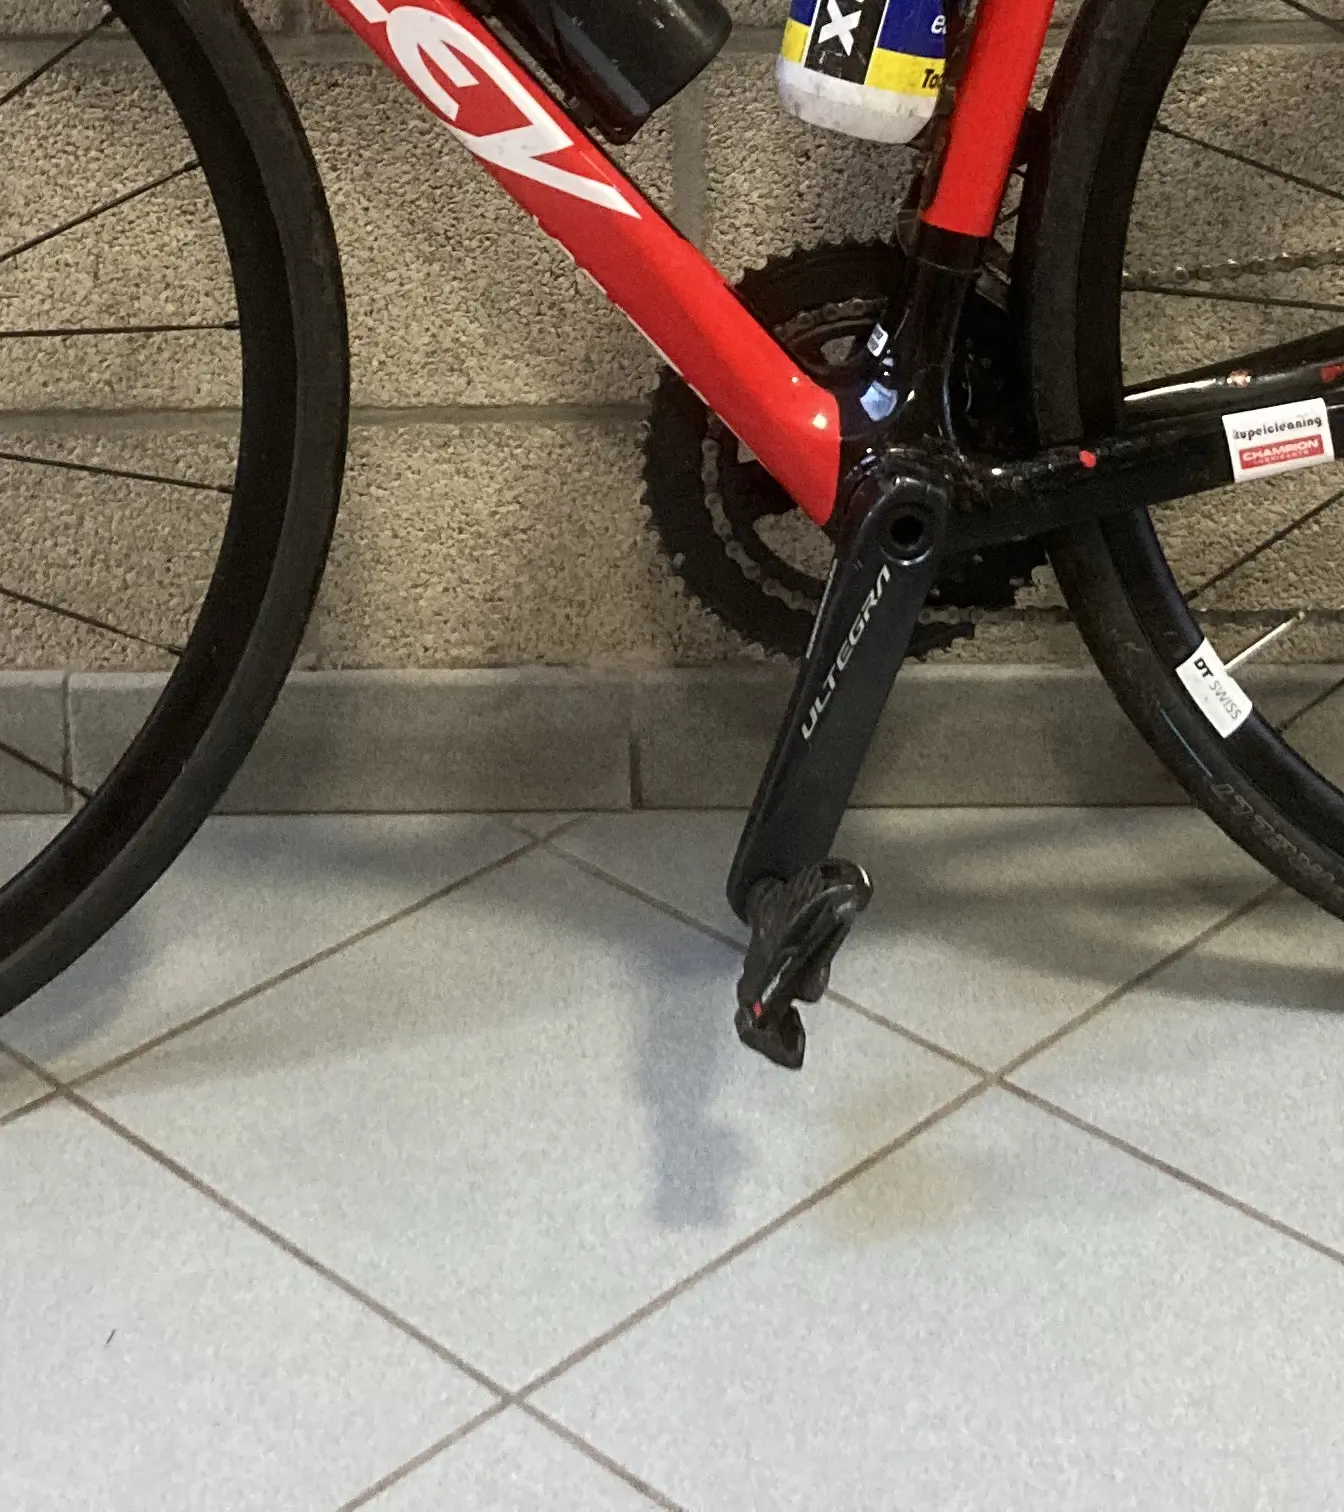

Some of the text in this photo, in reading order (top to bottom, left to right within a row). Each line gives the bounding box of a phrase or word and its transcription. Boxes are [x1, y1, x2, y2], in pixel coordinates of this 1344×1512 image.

[801, 564, 891, 740] ULTEGRA
[1193, 657, 1242, 721] DT SWISS
